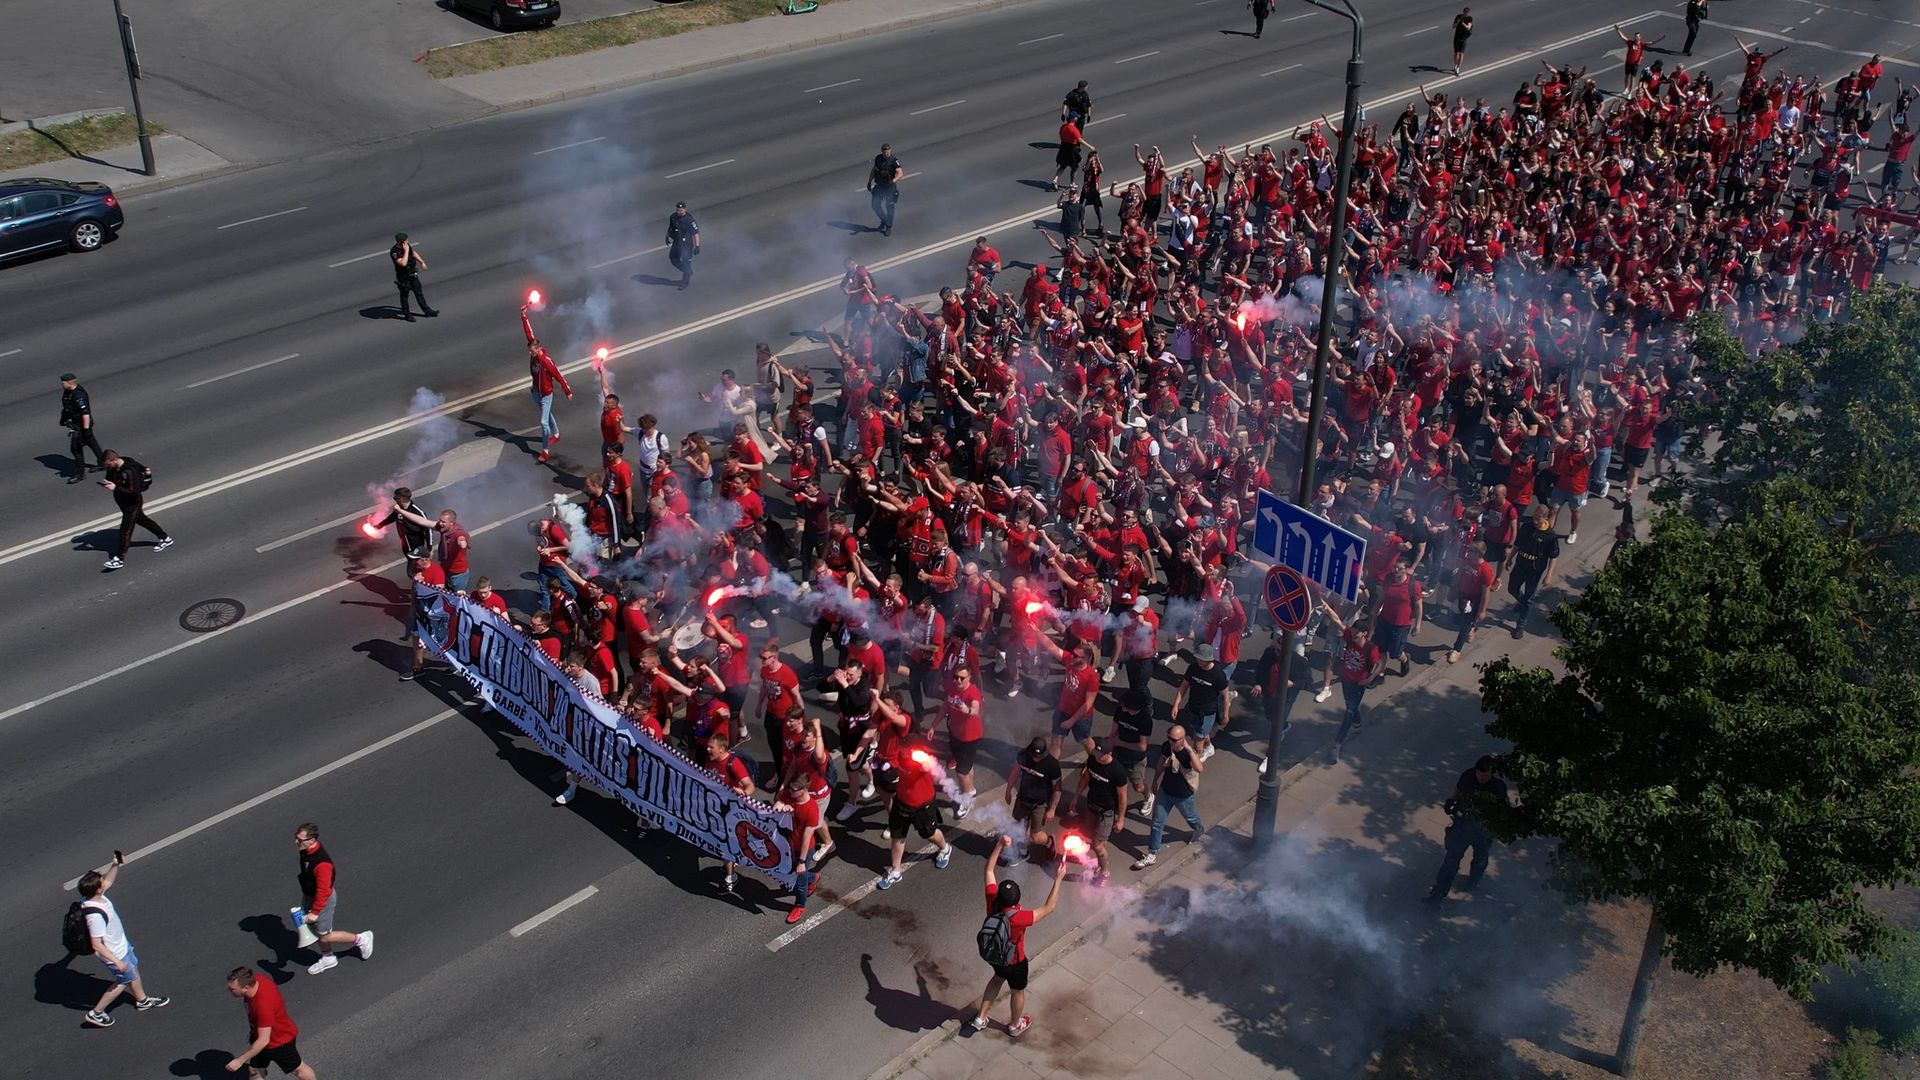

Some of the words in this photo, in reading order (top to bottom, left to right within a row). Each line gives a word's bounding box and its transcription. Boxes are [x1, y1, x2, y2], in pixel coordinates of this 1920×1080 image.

[492, 689, 527, 719] GARBĖ
[571, 703, 631, 788] RYTAS
[635, 744, 727, 843] VILNIUS
